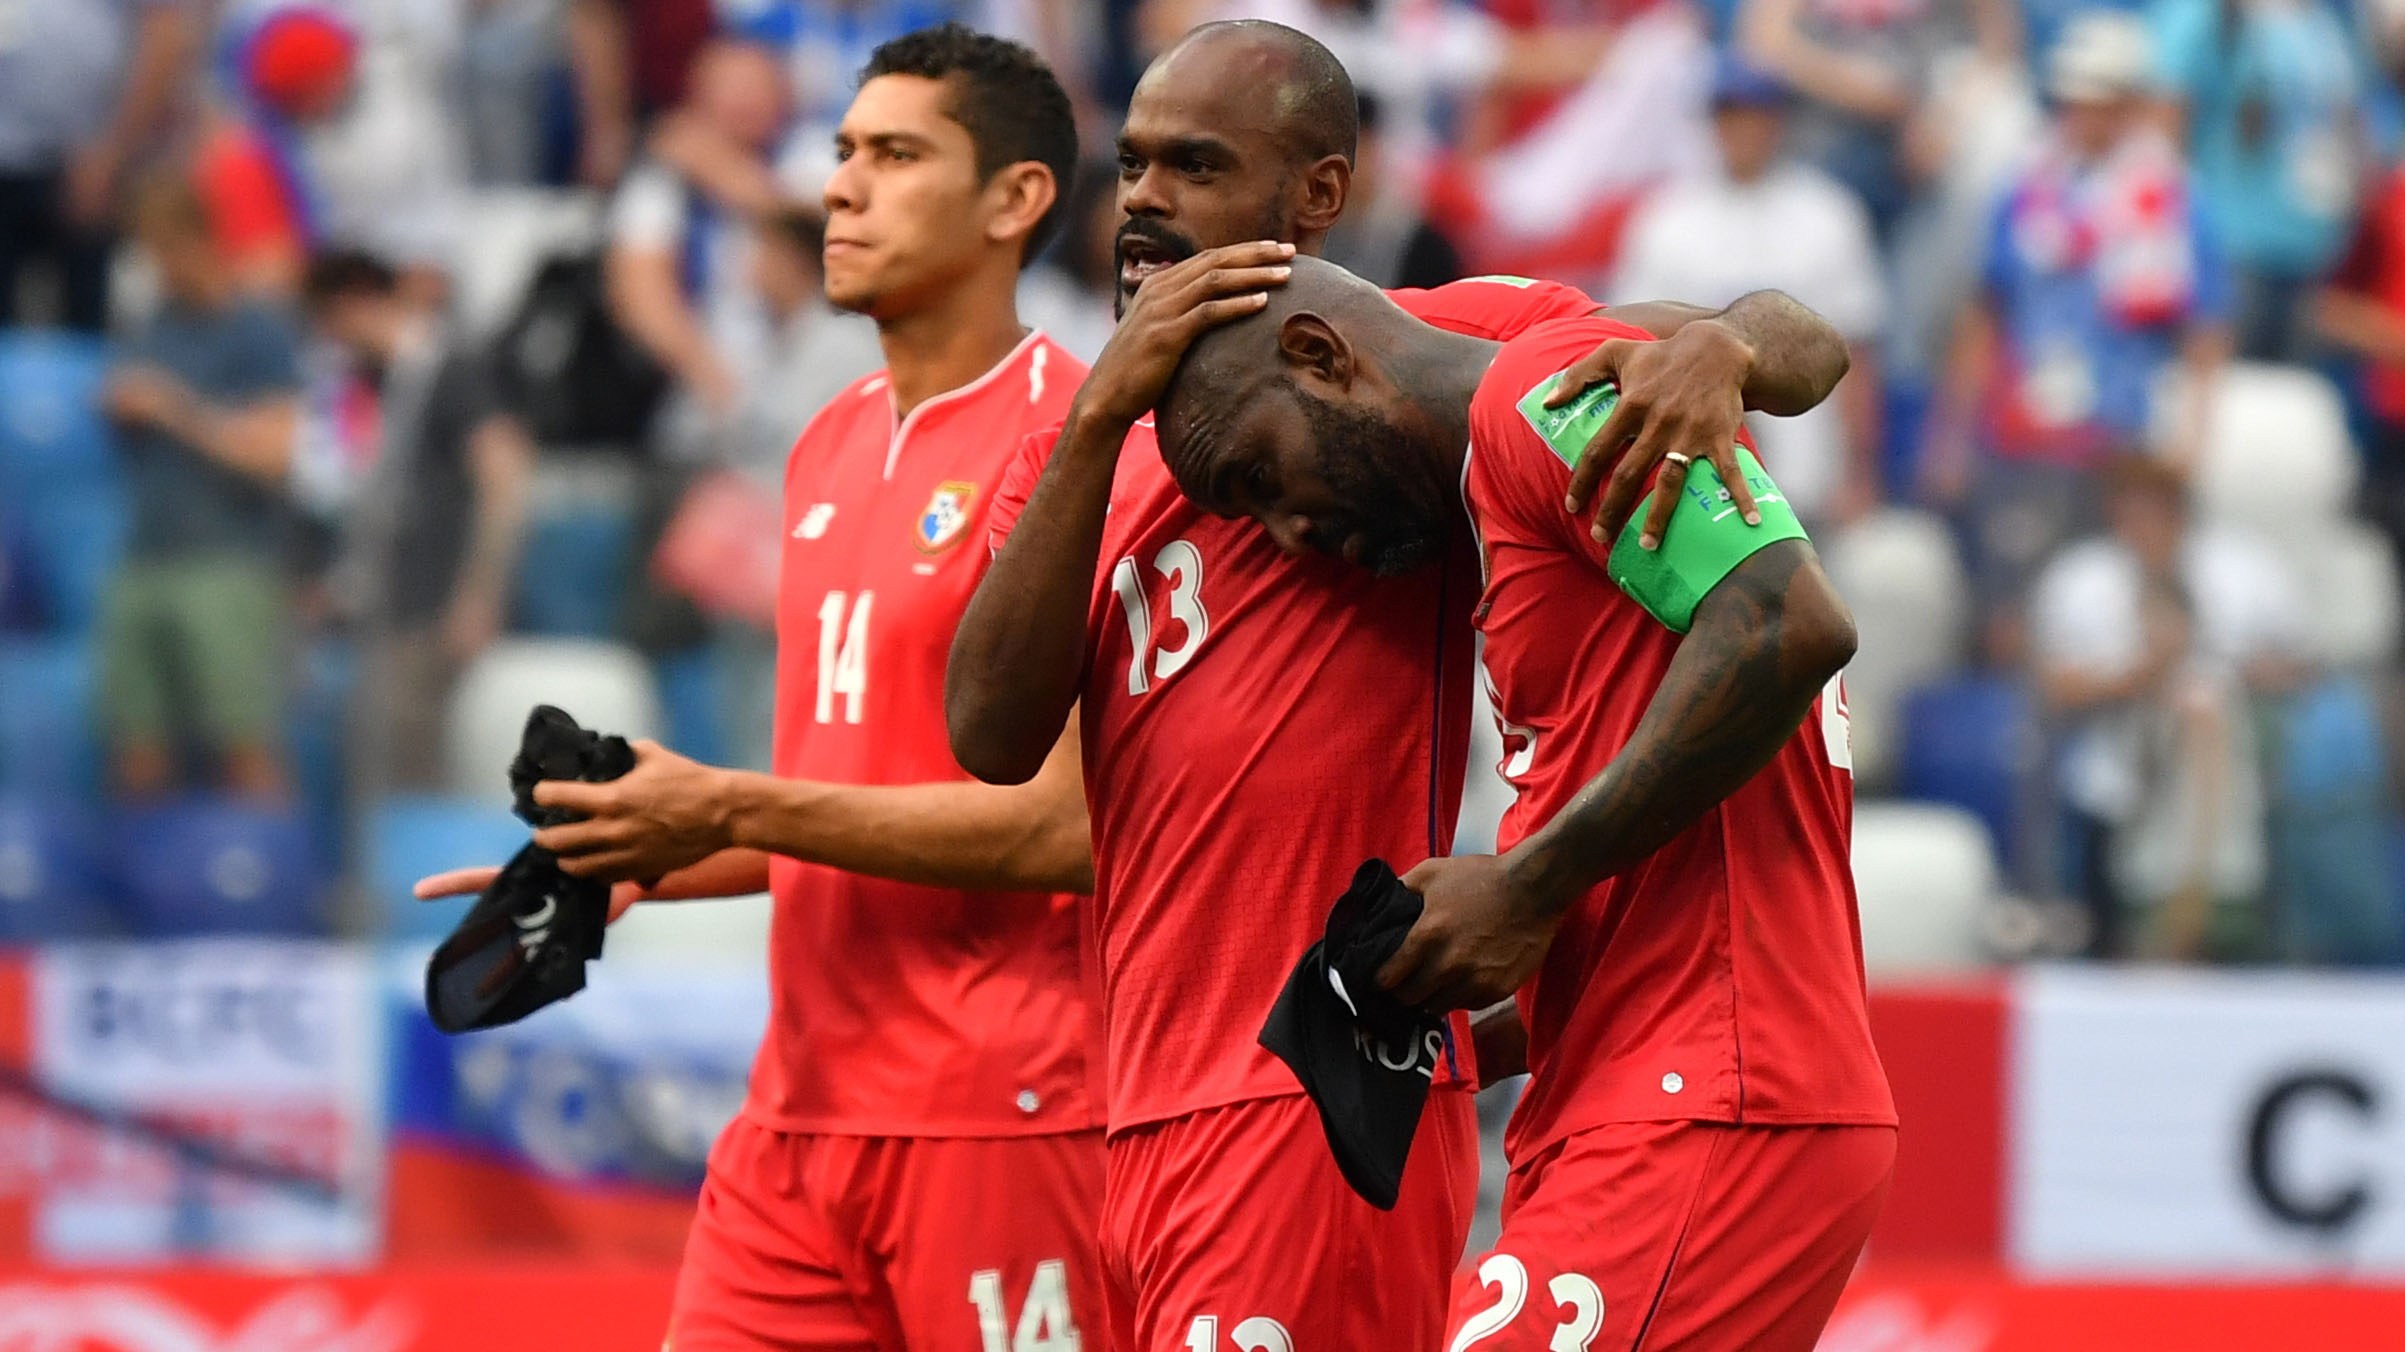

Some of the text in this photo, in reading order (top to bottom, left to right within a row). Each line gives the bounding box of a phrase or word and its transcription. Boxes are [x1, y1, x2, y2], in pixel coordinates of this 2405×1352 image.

[815, 590, 875, 724] 14
[1112, 539, 1209, 697] 13
[2243, 1068, 2376, 1230] C
[967, 1257, 1083, 1352] 14
[1449, 1254, 1604, 1352] 23
